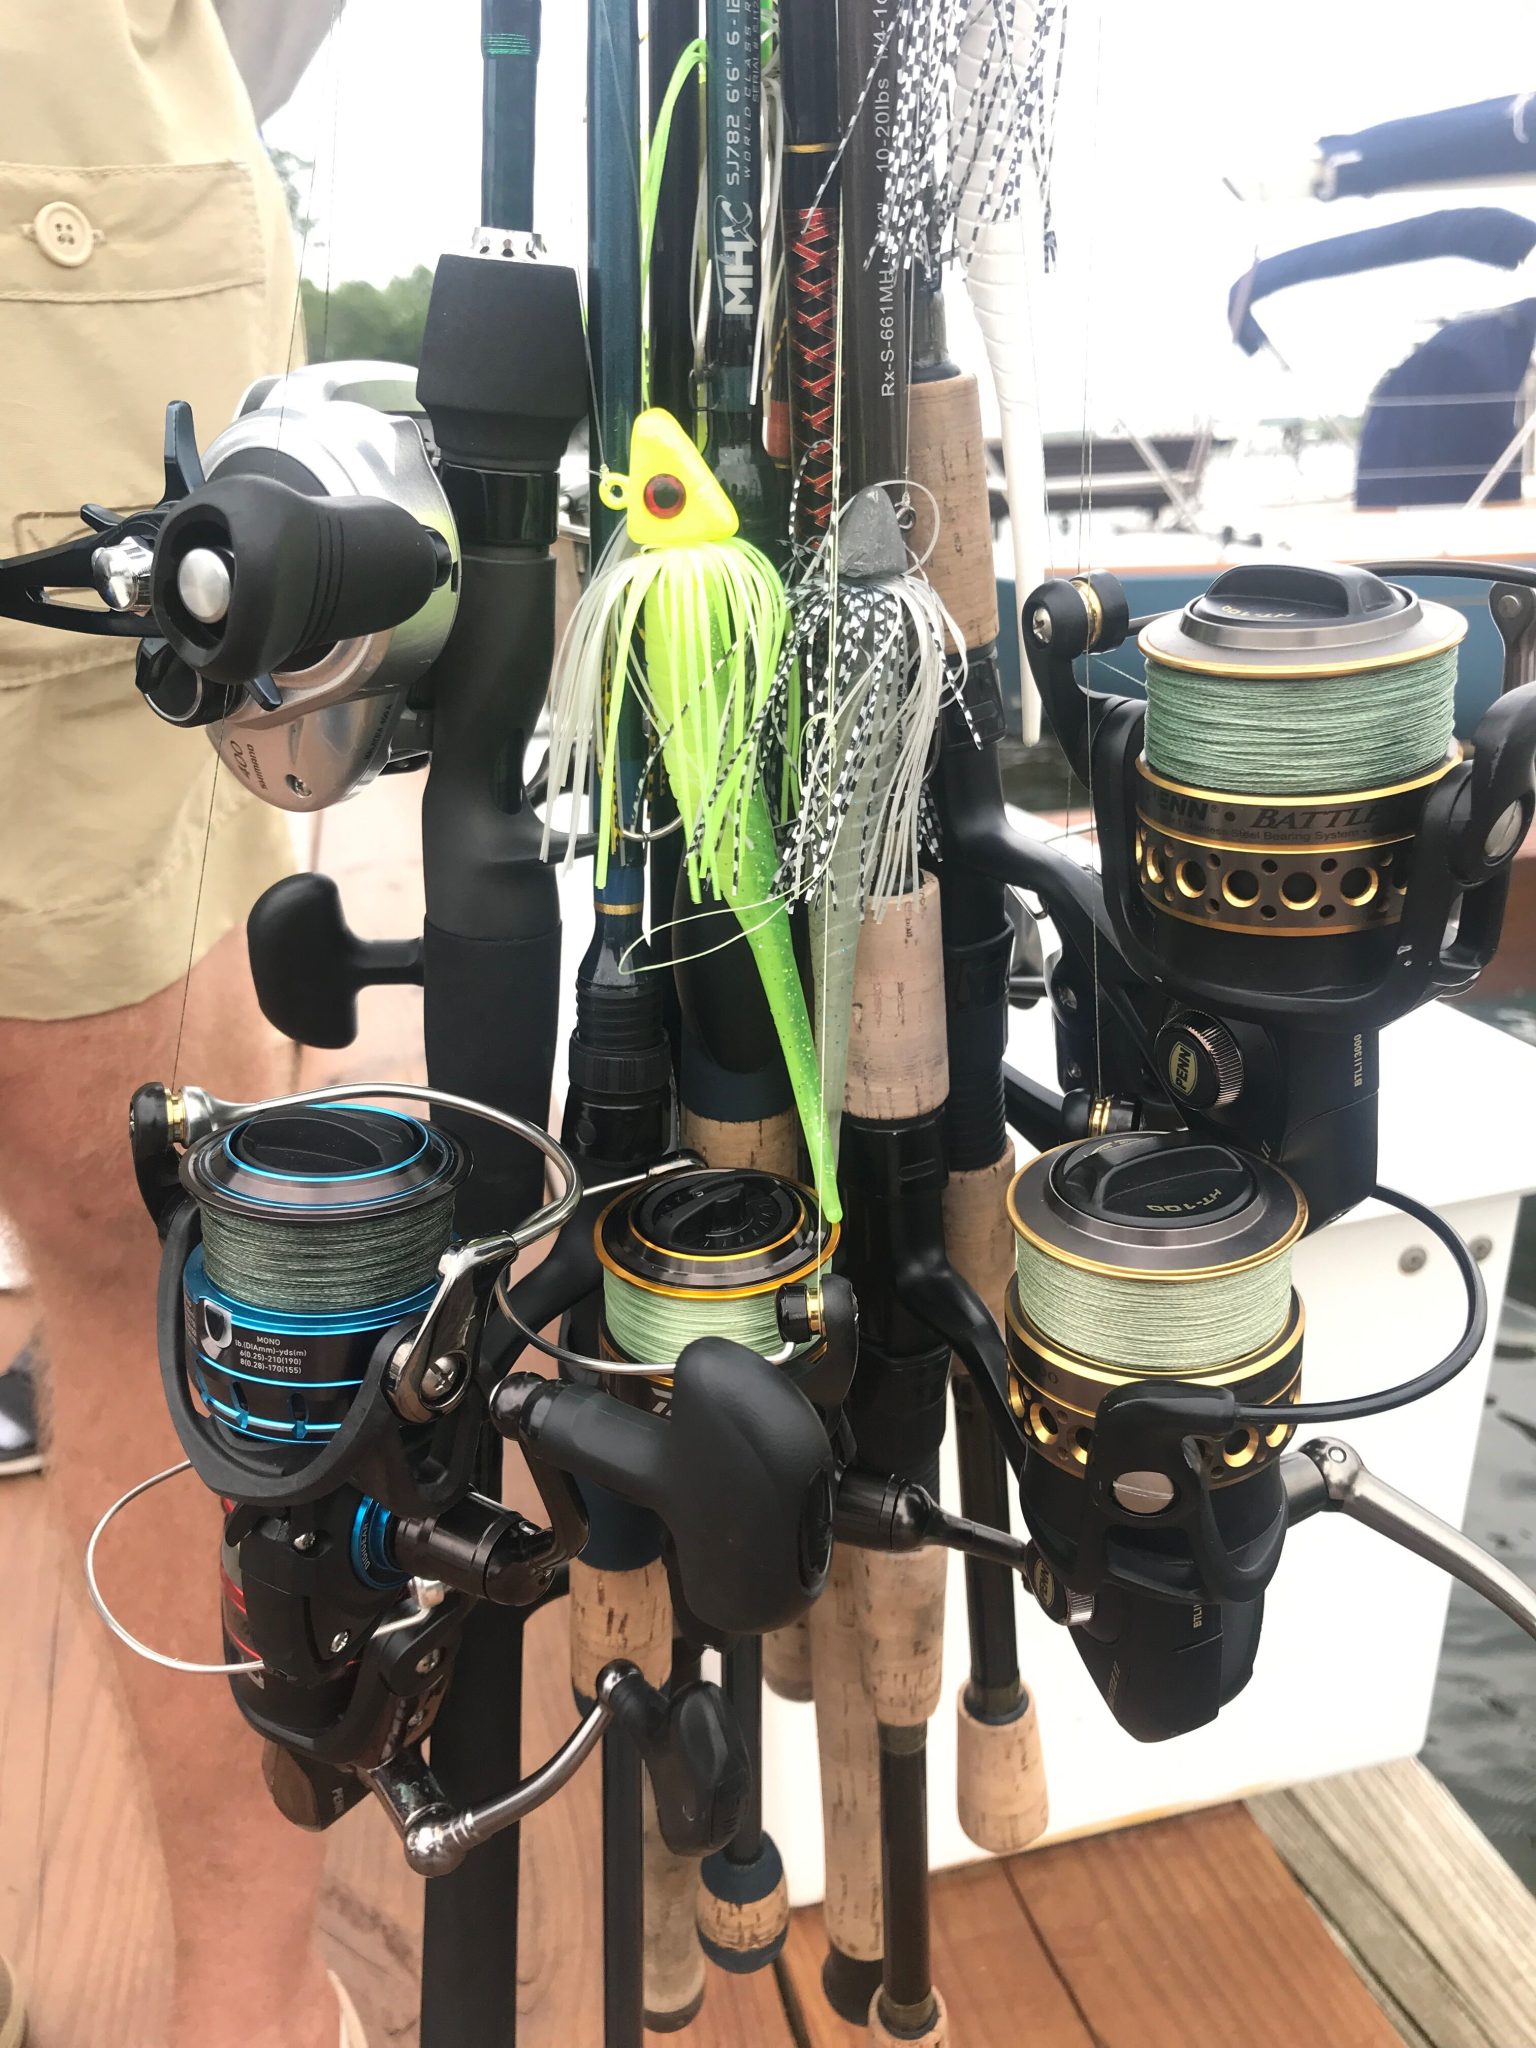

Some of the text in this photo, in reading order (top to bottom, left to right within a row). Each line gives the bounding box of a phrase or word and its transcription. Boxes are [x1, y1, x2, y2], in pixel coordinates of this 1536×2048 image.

[875, 78, 890, 172] 10-20lbs
[726, 114, 740, 186] SJ782
[1175, 1047, 1192, 1090] PENN
[1146, 1188, 1222, 1212] HT-100
[256, 1335, 281, 1346] MONO
